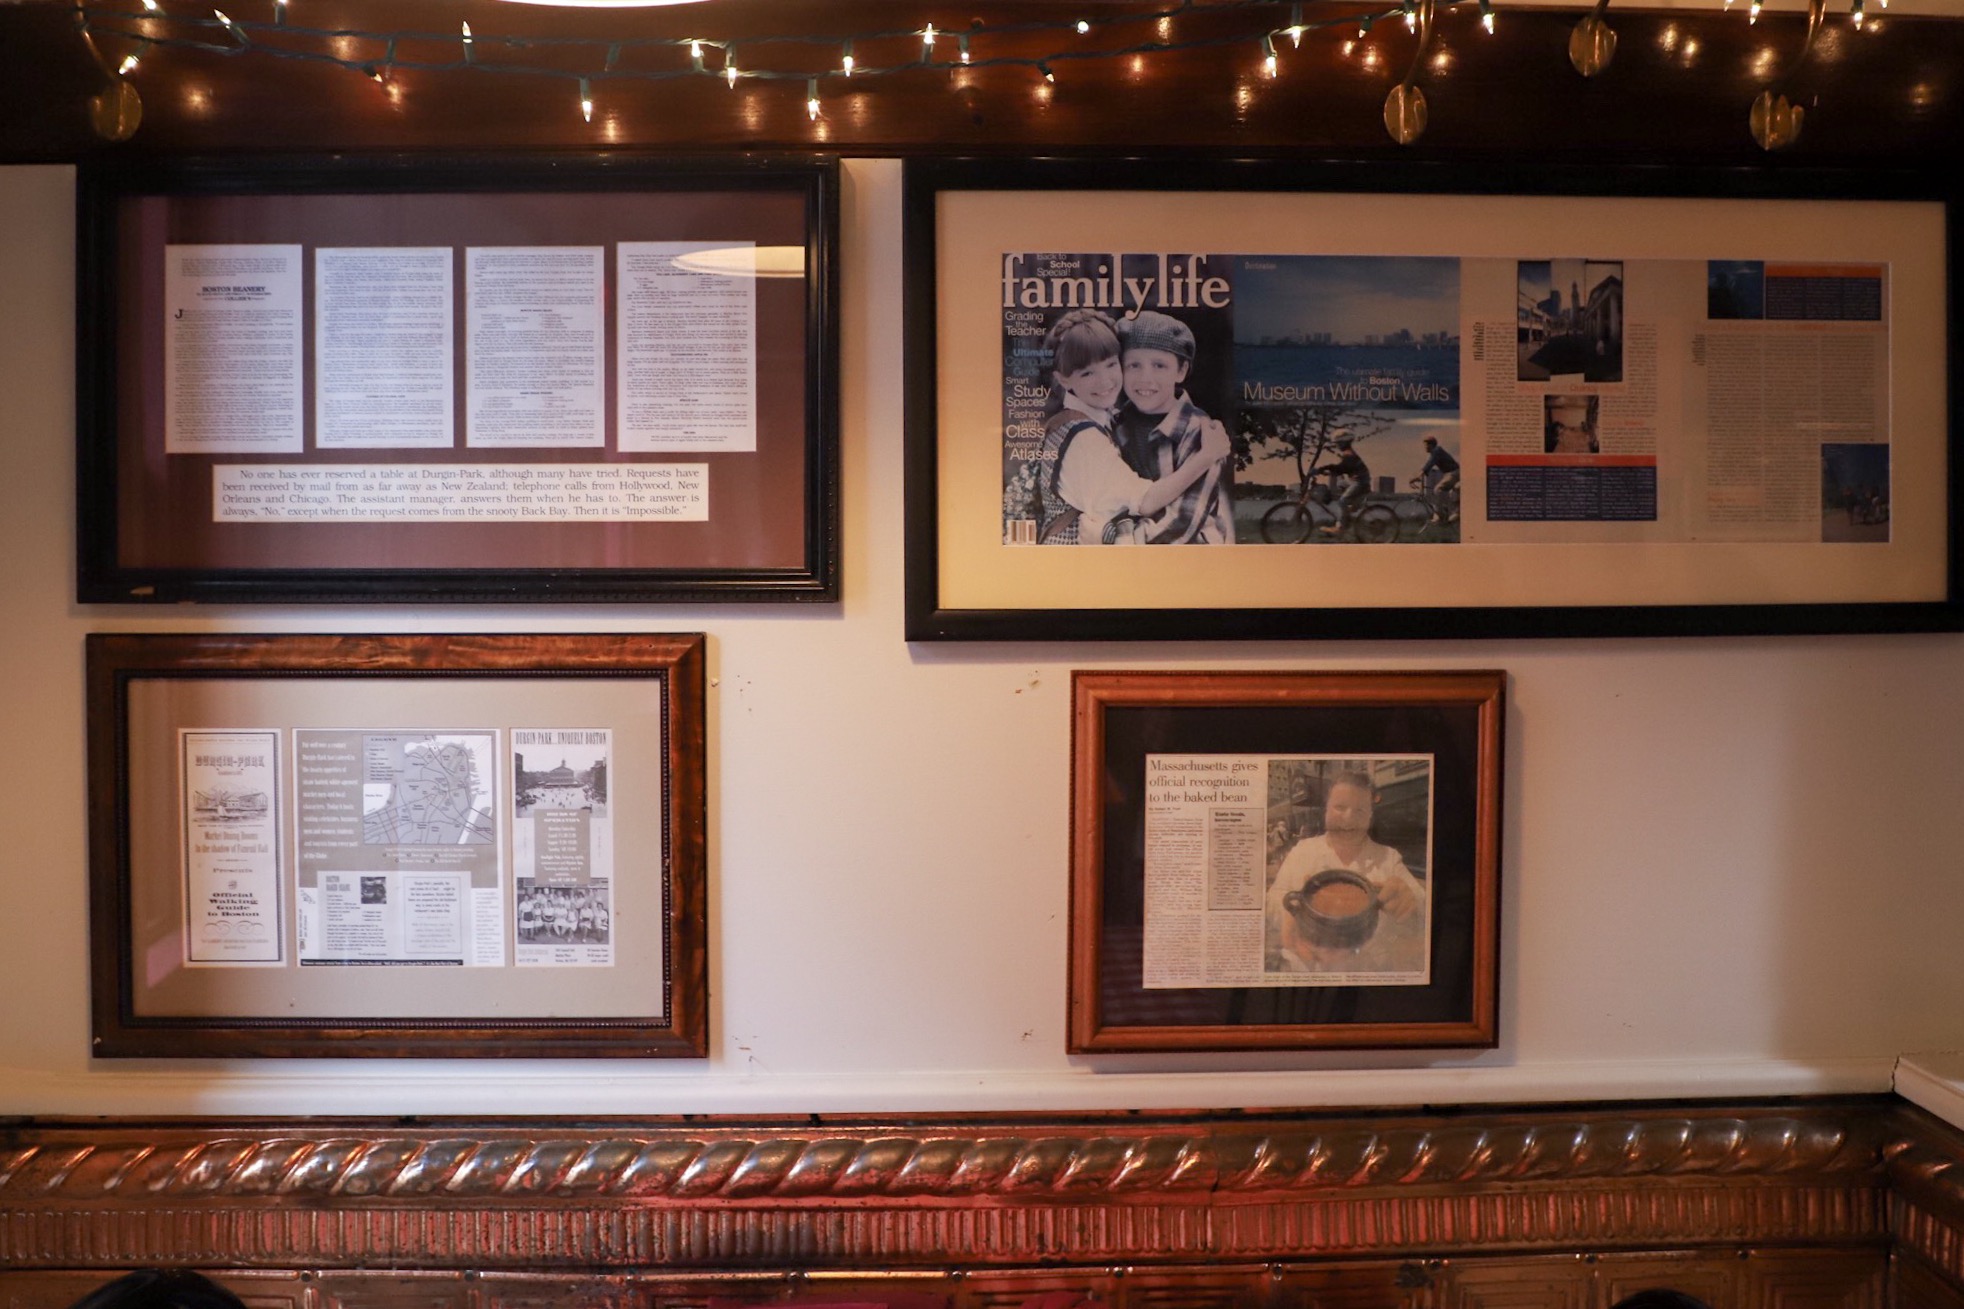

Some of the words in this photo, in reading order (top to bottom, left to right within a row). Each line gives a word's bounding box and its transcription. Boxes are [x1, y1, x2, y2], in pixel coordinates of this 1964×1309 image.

[1050, 261, 1080, 269] School
[1037, 268, 1071, 278] Special!
[1005, 311, 1044, 323] Grading
[1005, 325, 1047, 336] Teacher
[1013, 348, 1054, 357] Ultimate
[1006, 377, 1030, 385] Smart
[1369, 376, 1400, 386] Boston
[1014, 385, 1051, 400] Study
[1244, 381, 1325, 402] Museum
[1329, 382, 1398, 402] Without
[1402, 383, 1449, 402] Walls
[1006, 397, 1046, 409] Spaces
[1008, 409, 1046, 419] Fashion
[1020, 419, 1040, 428] with
[1006, 425, 1046, 439] Class
[1009, 448, 1059, 462] Atlases
[240, 471, 254, 479] No
[257, 472, 275, 480] one
[278, 470, 297, 479] has
[325, 471, 366, 479] reserved
[380, 470, 404, 479] table
[408, 471, 418, 479] at
[489, 470, 533, 481] although
[537, 472, 565, 481] many
[569, 469, 593, 478] have
[627, 469, 672, 480] Requests
[676, 469, 699, 478] have
[222, 483, 245, 491] been
[250, 483, 289, 492] received
[294, 482, 305, 494] by
[310, 482, 330, 491] mail
[336, 482, 358, 491] from
[379, 482, 391, 492] far
[397, 485, 421, 494] away
[442, 483, 462, 491] New
[514, 482, 560, 493] telephone
[565, 482, 587, 491] calls
[592, 481, 614, 491] from
[679, 481, 699, 490] New
[222, 495, 261, 504] Orleans
[266, 495, 284, 504] and
[338, 495, 355, 504] The
[361, 496, 404, 504] assistant
[507, 495, 532, 504] them
[537, 495, 563, 503] when
[569, 494, 581, 503] he
[586, 494, 604, 503] has
[626, 494, 645, 503] The
[692, 495, 699, 503] is
[287, 509, 319, 519] except
[321, 508, 348, 516] when
[351, 507, 367, 516] the
[370, 509, 406, 519] request
[442, 507, 465, 516] from
[468, 507, 484, 516] the
[486, 509, 519, 518] snooty
[521, 507, 546, 516] Back
[549, 507, 570, 518] Bay.
[573, 507, 599, 516] Then
[602, 508, 608, 516] it
[612, 508, 620, 516] is
[585, 732, 606, 744] BOSTON
[1150, 759, 1228, 771] Massachusetts
[1232, 760, 1259, 774] gives
[1149, 775, 1185, 787] official
[1189, 775, 1250, 790] recognition
[1149, 793, 1160, 803] to
[1163, 791, 1180, 803] the
[1183, 791, 1217, 803] baked
[1221, 791, 1248, 803] bean
